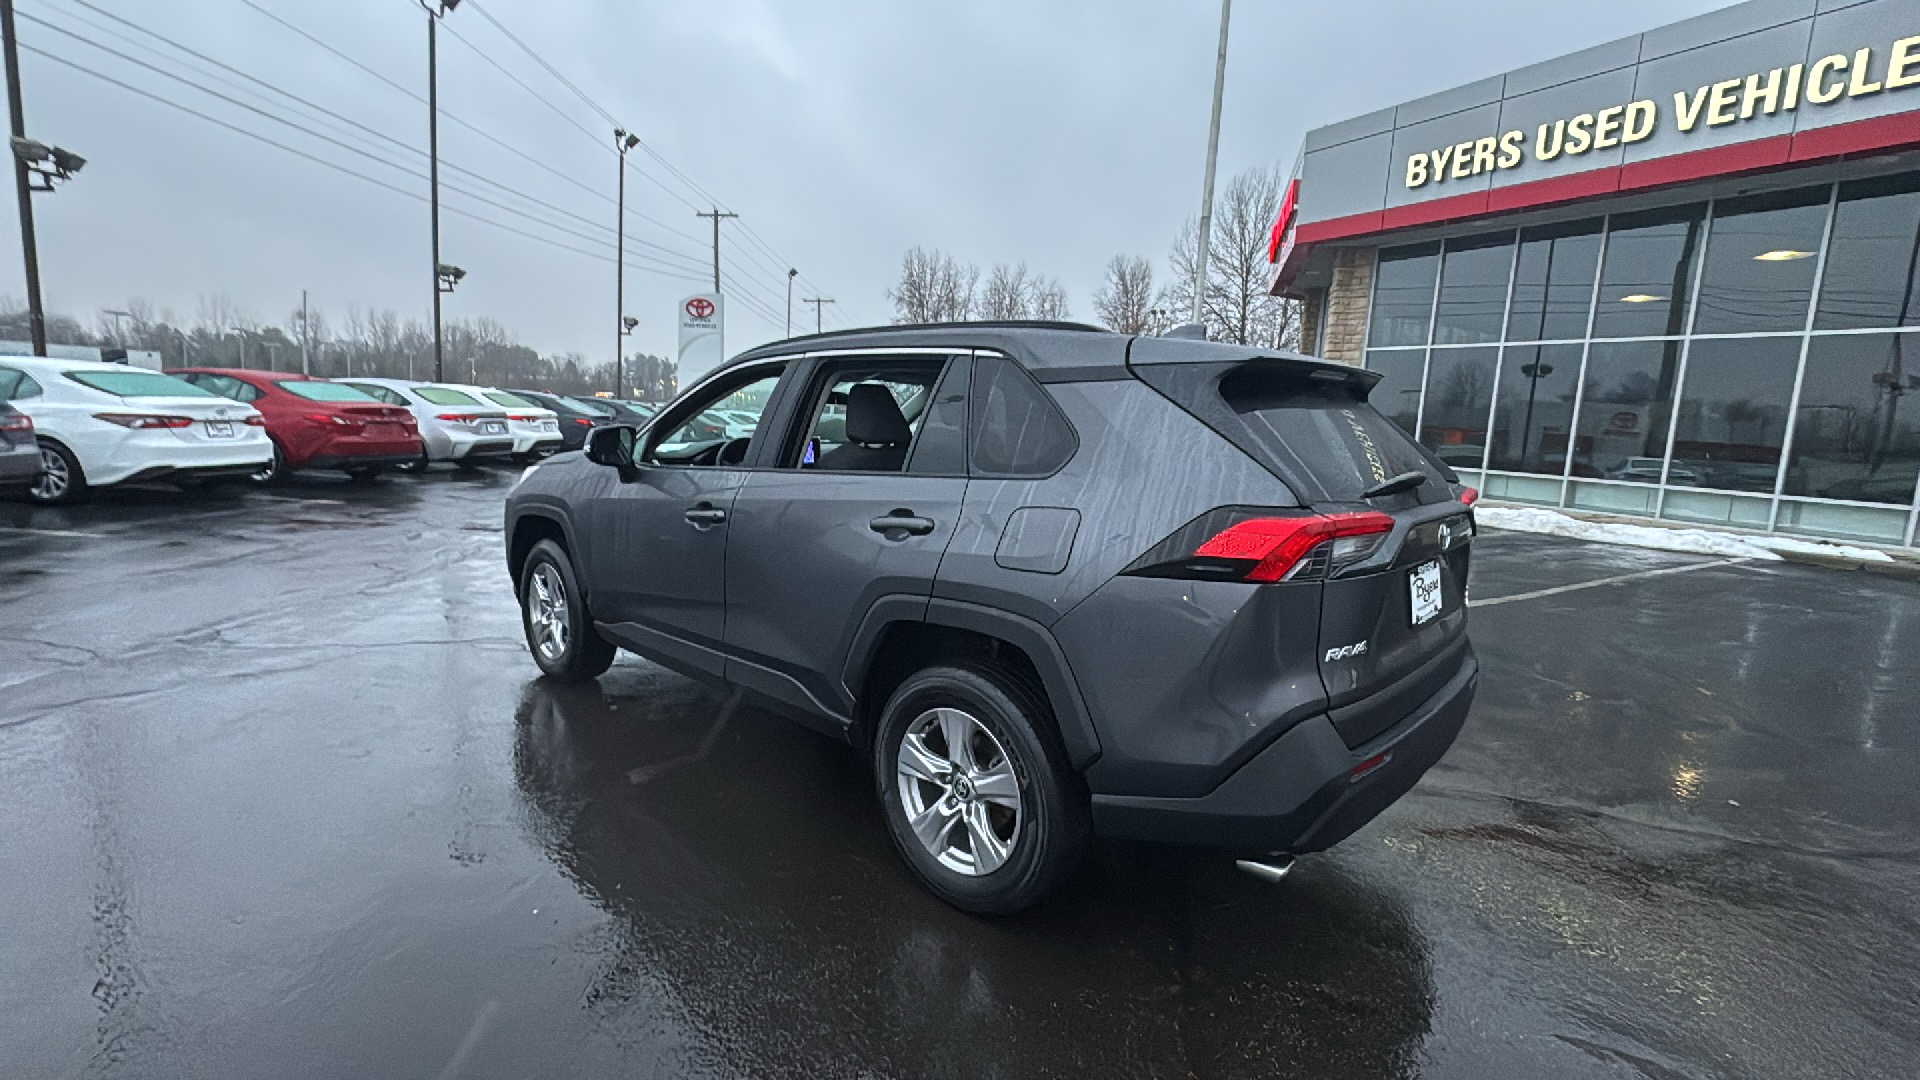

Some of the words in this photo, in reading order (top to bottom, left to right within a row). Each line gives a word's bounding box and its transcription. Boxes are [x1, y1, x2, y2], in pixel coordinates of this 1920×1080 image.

[1405, 130, 1526, 188] BYERS
[1535, 99, 1656, 161] USED
[1673, 35, 1920, 132] VEHICLE
[1324, 639, 1368, 663] RAV4
